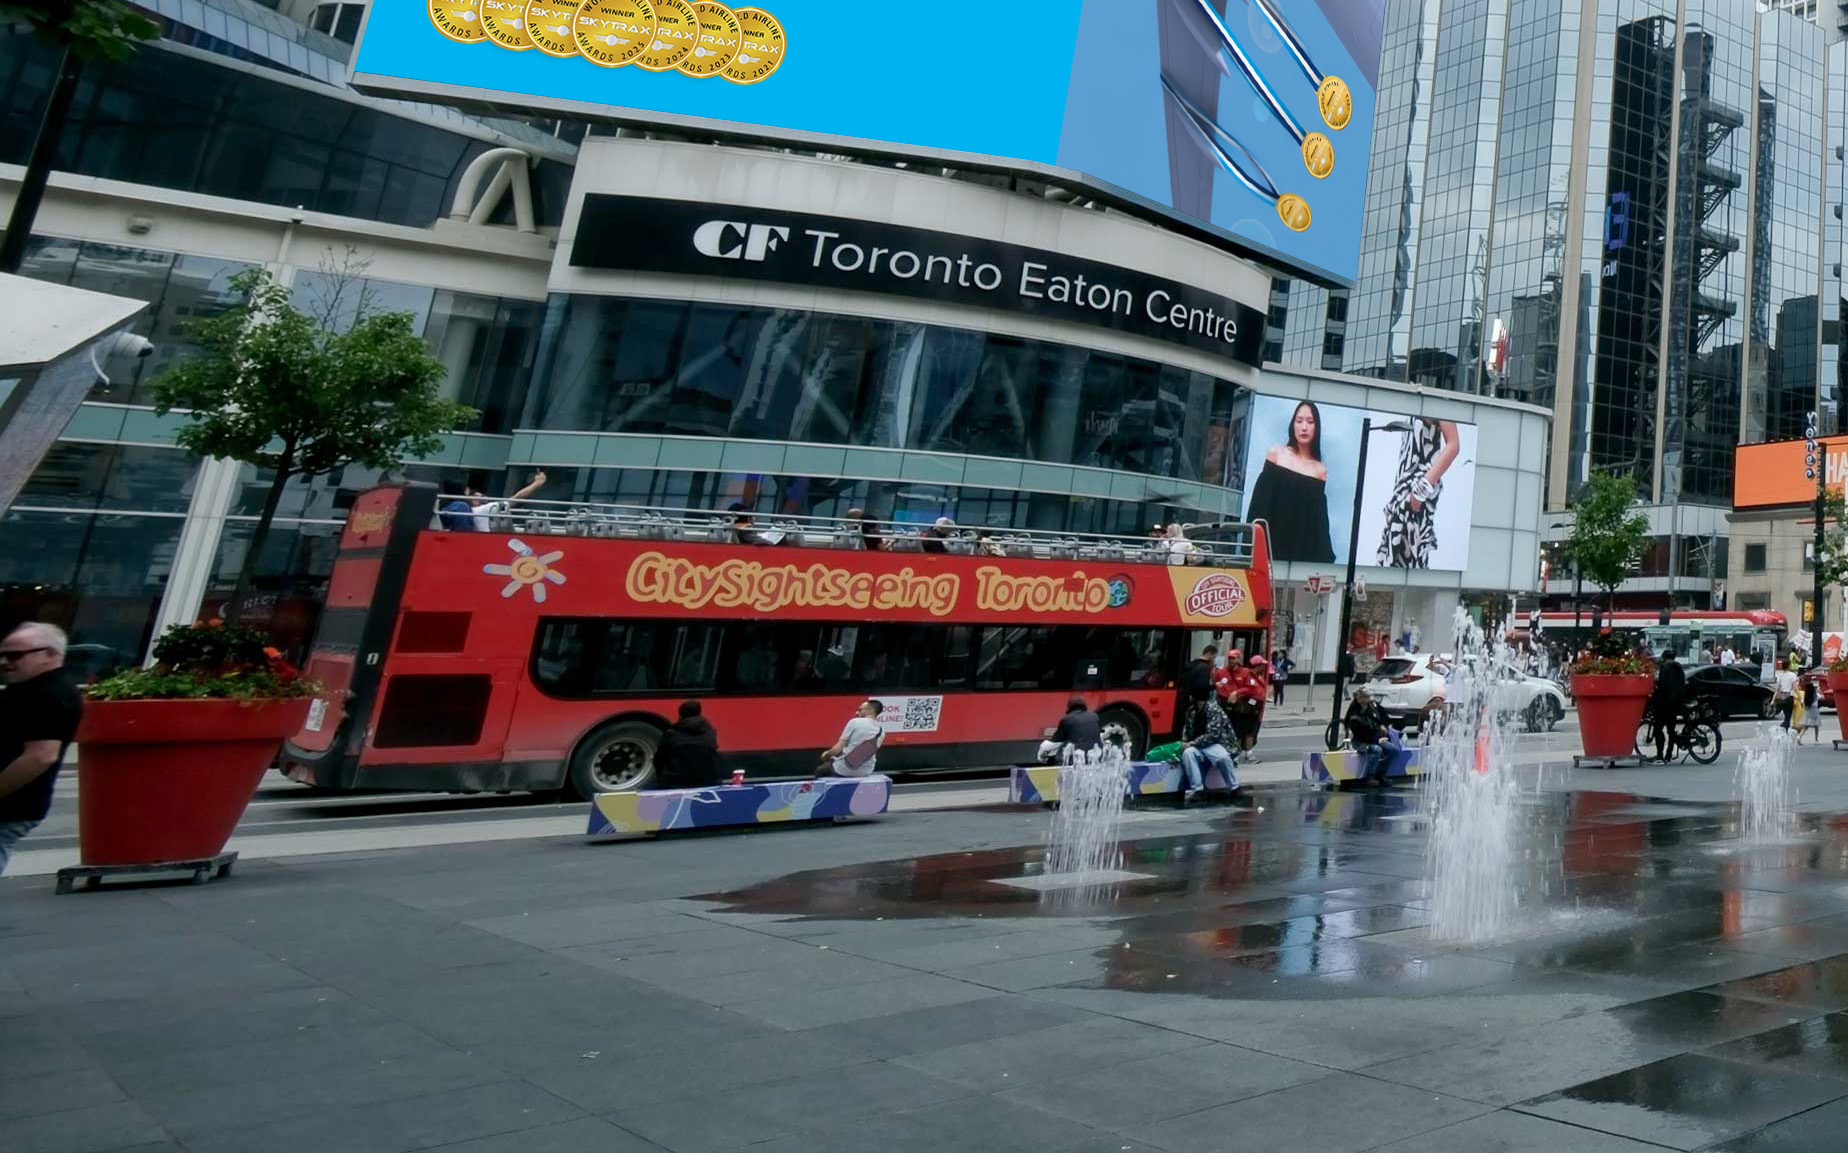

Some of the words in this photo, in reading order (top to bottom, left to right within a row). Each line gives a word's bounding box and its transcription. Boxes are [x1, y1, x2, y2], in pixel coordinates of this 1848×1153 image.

[486, 0, 524, 13] SKYT
[531, 7, 572, 20] SKYT
[601, 7, 635, 18] WINNER
[434, 7, 471, 38] AWARDS
[579, 16, 651, 35] SKYTRAX
[709, 5, 738, 34] AIRLINE
[752, 12, 781, 41] AIRLINE
[484, 15, 520, 45] AWARDS
[529, 22, 564, 52] AWARDS
[577, 31, 613, 62] AWARDS
[621, 41, 645, 60] 2025
[666, 47, 689, 64] 2024
[709, 53, 731, 71] 2023
[752, 60, 774, 77] 2021
[693, 221, 790, 261] CF
[805, 230, 1002, 290] Toronto
[1019, 262, 1132, 315] Eaton
[1146, 290, 1237, 344] Centre
[1192, 588, 1244, 609] OFFICIAL
[1212, 602, 1233, 613] TOUR
